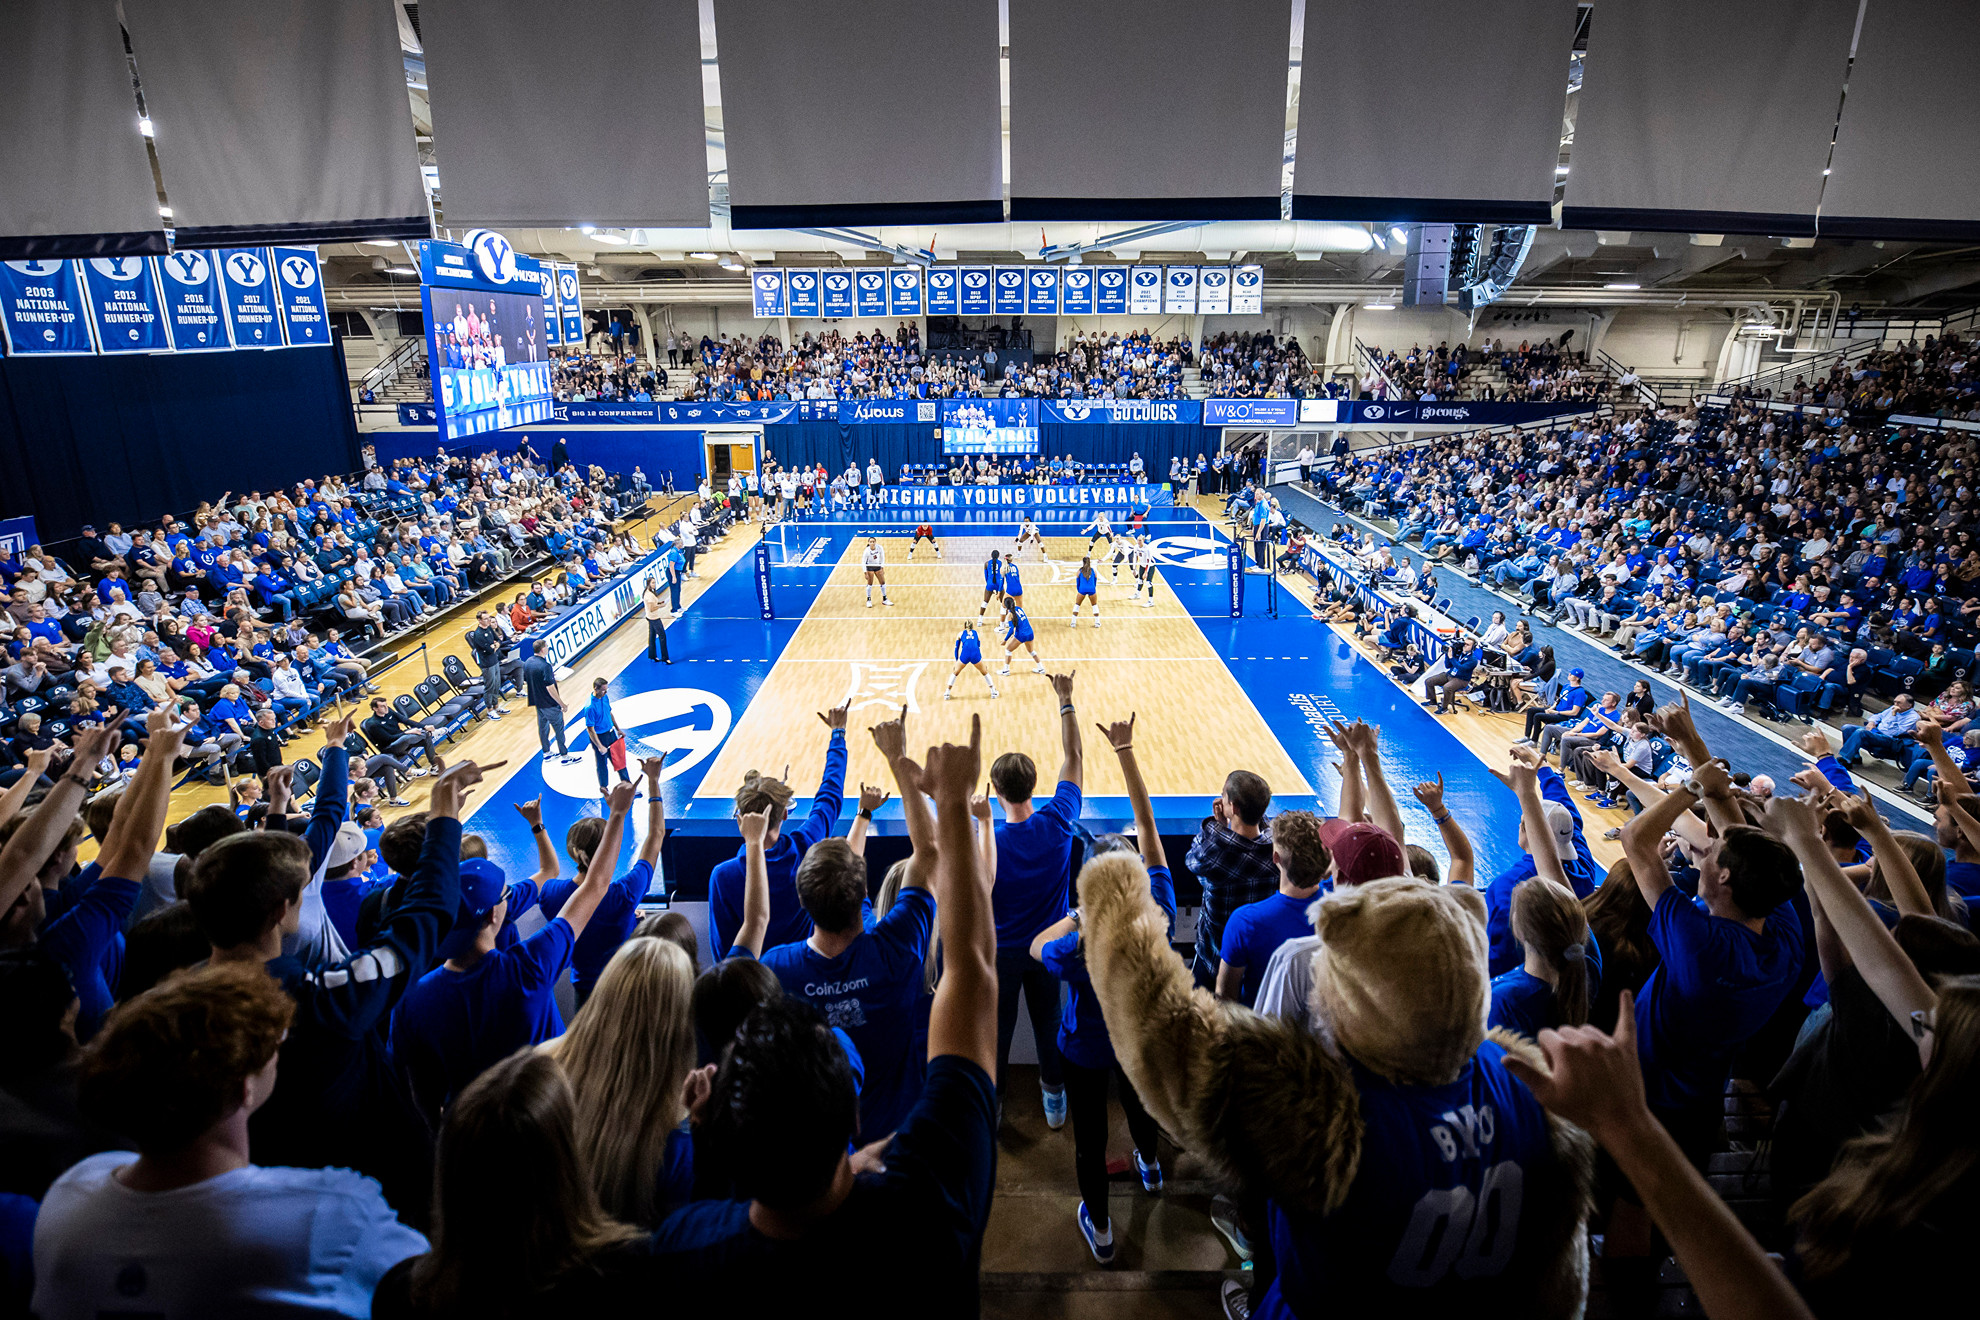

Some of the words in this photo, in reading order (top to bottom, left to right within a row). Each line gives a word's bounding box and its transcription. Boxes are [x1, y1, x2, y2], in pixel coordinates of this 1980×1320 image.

[26, 287, 55, 298] 2003
[114, 291, 136, 300] 2013
[184, 294, 204, 303] 2016
[244, 295, 260, 303] 2017
[16, 299, 69, 311] NATIONAL
[104, 302, 150, 312] NATIONAL
[177, 305, 214, 313] NATIONAL
[238, 305, 269, 313] NATIONAL
[15, 312, 75, 323] RUNNER-UP
[104, 314, 154, 323] RUNNER-UP
[177, 316, 218, 324] RUNNER-UP
[238, 315, 272, 323] RUNNER-UP
[854, 405, 904, 419] smarty
[1113, 404, 1131, 420] GO
[1133, 404, 1177, 420] COUGS
[963, 488, 1025, 504] YOUNG
[1034, 487, 1149, 503] VOLLEYBALL
[1309, 694, 1350, 724] OURT
[805, 978, 868, 996] CoinZoom
[1386, 1160, 1523, 1287] 00
